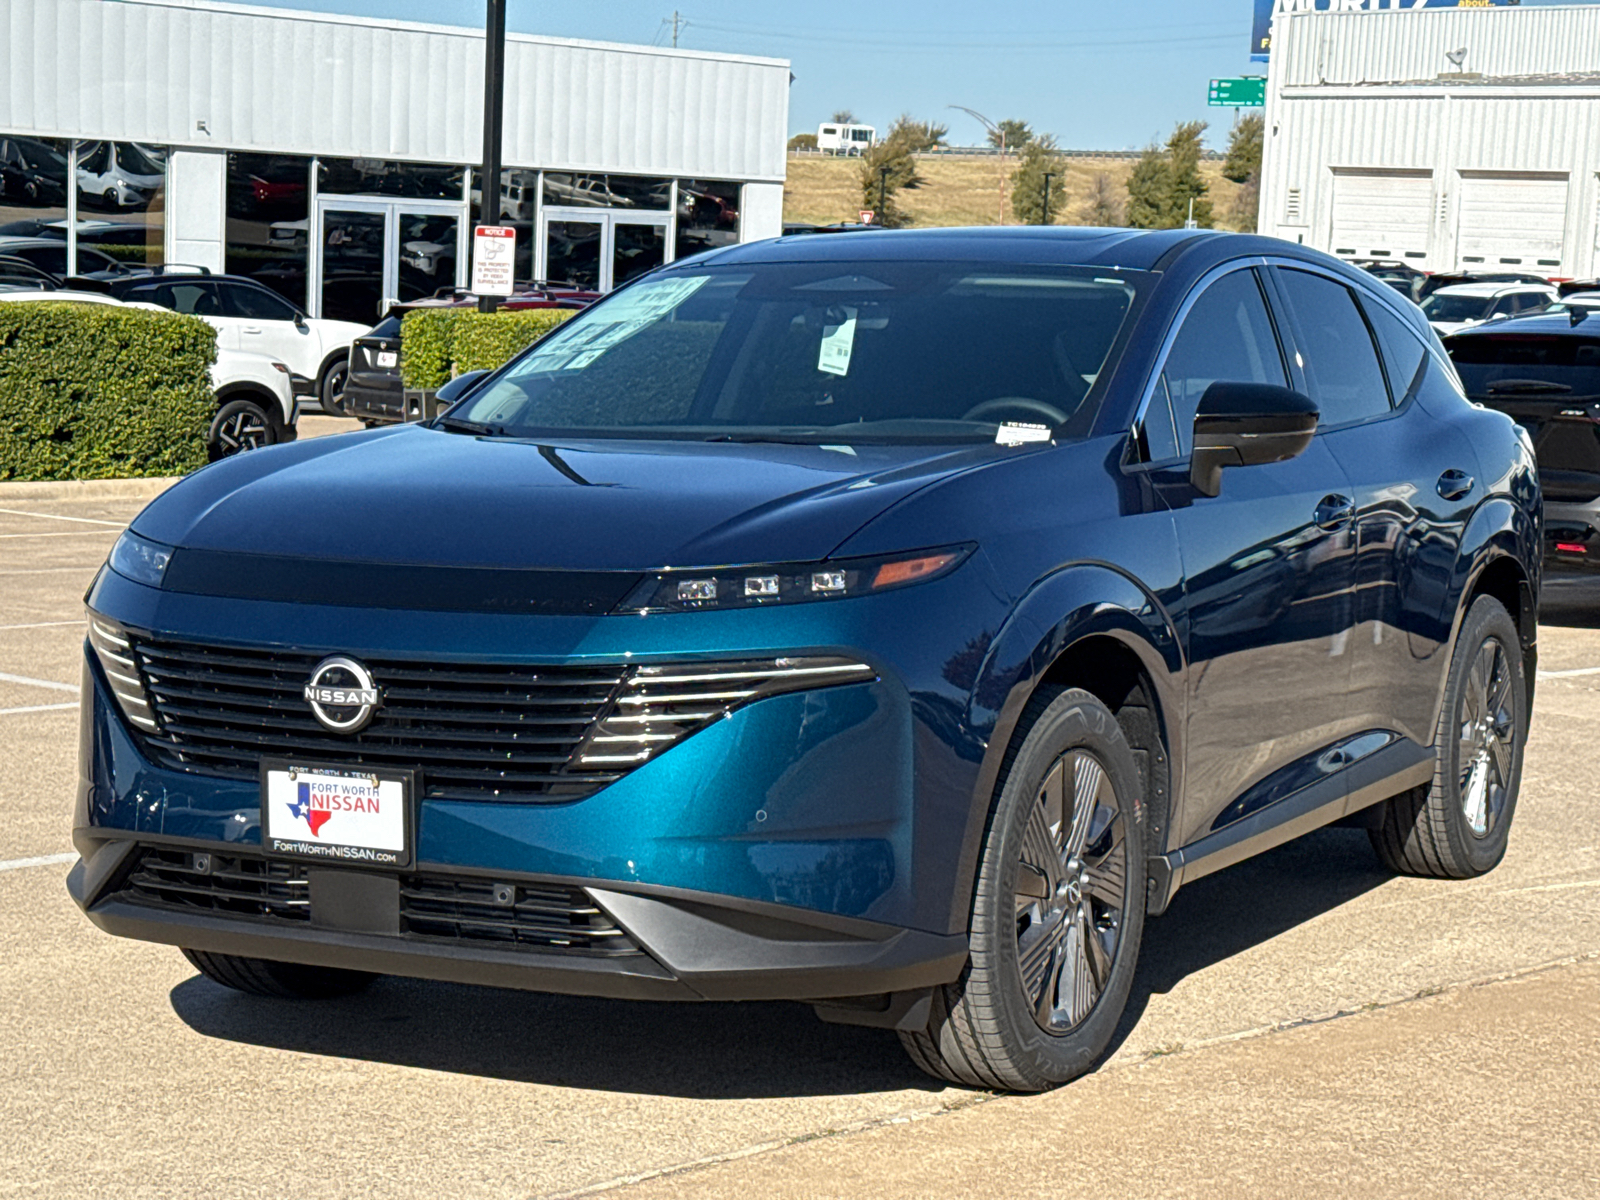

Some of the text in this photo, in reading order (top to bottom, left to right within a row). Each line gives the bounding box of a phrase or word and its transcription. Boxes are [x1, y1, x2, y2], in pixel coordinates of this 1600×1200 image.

[305, 687, 375, 703] NISSAN
[312, 768, 340, 776] WORTH
[351, 771, 377, 779] TEXAS
[311, 783, 379, 797] FORT WORTH
[312, 793, 380, 814] NISSAN
